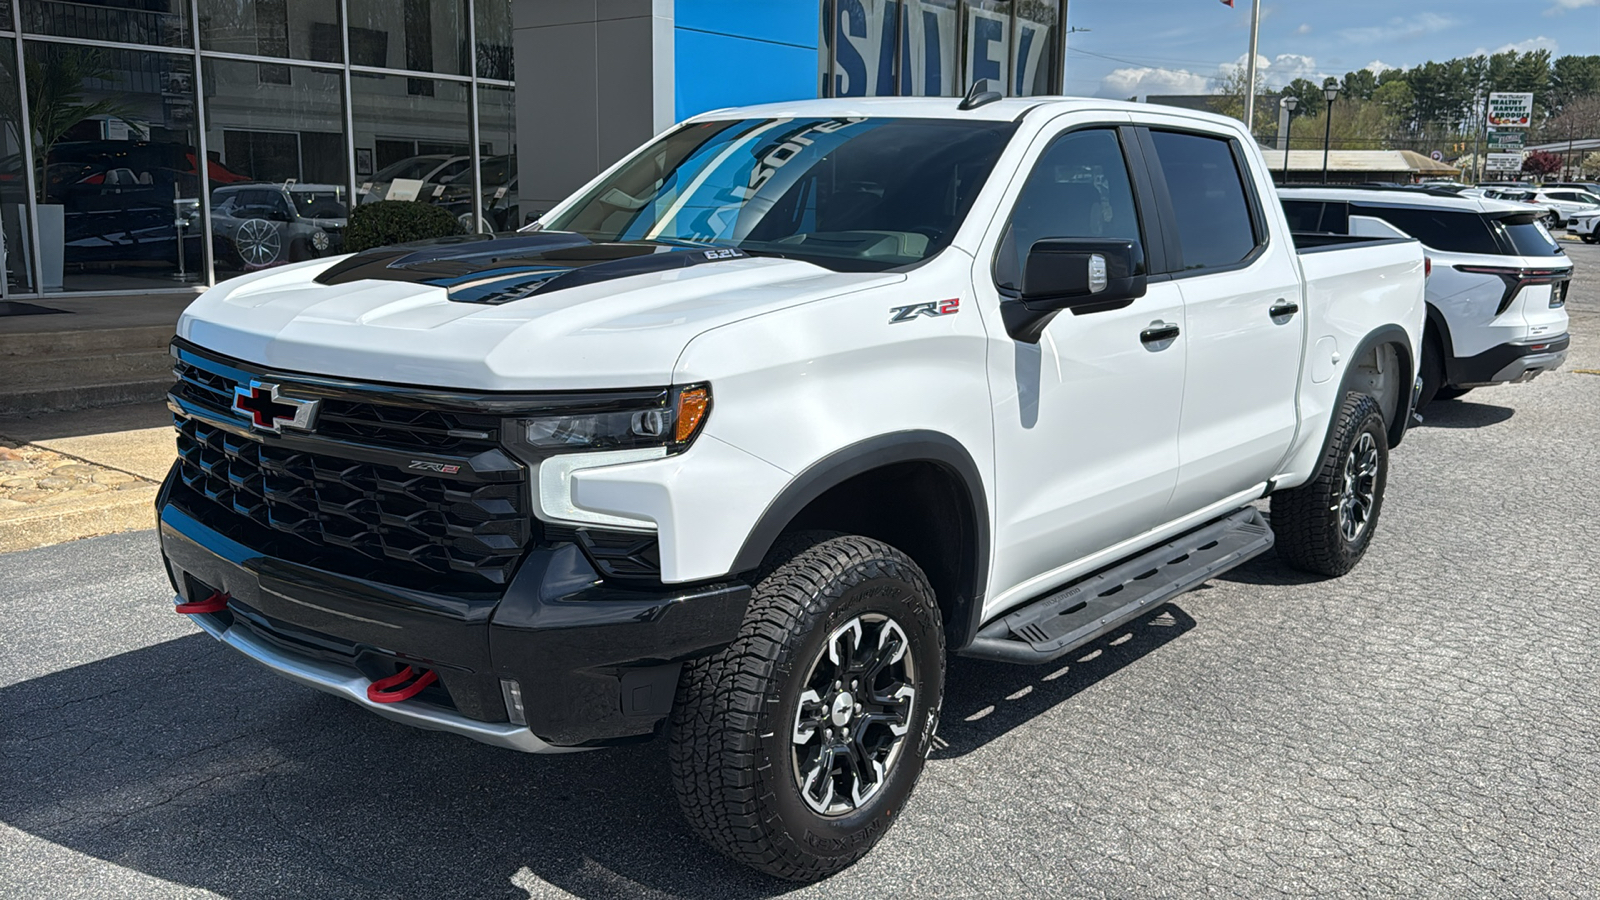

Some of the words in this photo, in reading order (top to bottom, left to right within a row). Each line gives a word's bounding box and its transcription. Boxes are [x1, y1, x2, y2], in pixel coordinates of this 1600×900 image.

[888, 298, 960, 325] ZR2
[408, 460, 461, 474] ZR2
[803, 818, 882, 851] NEXEN
